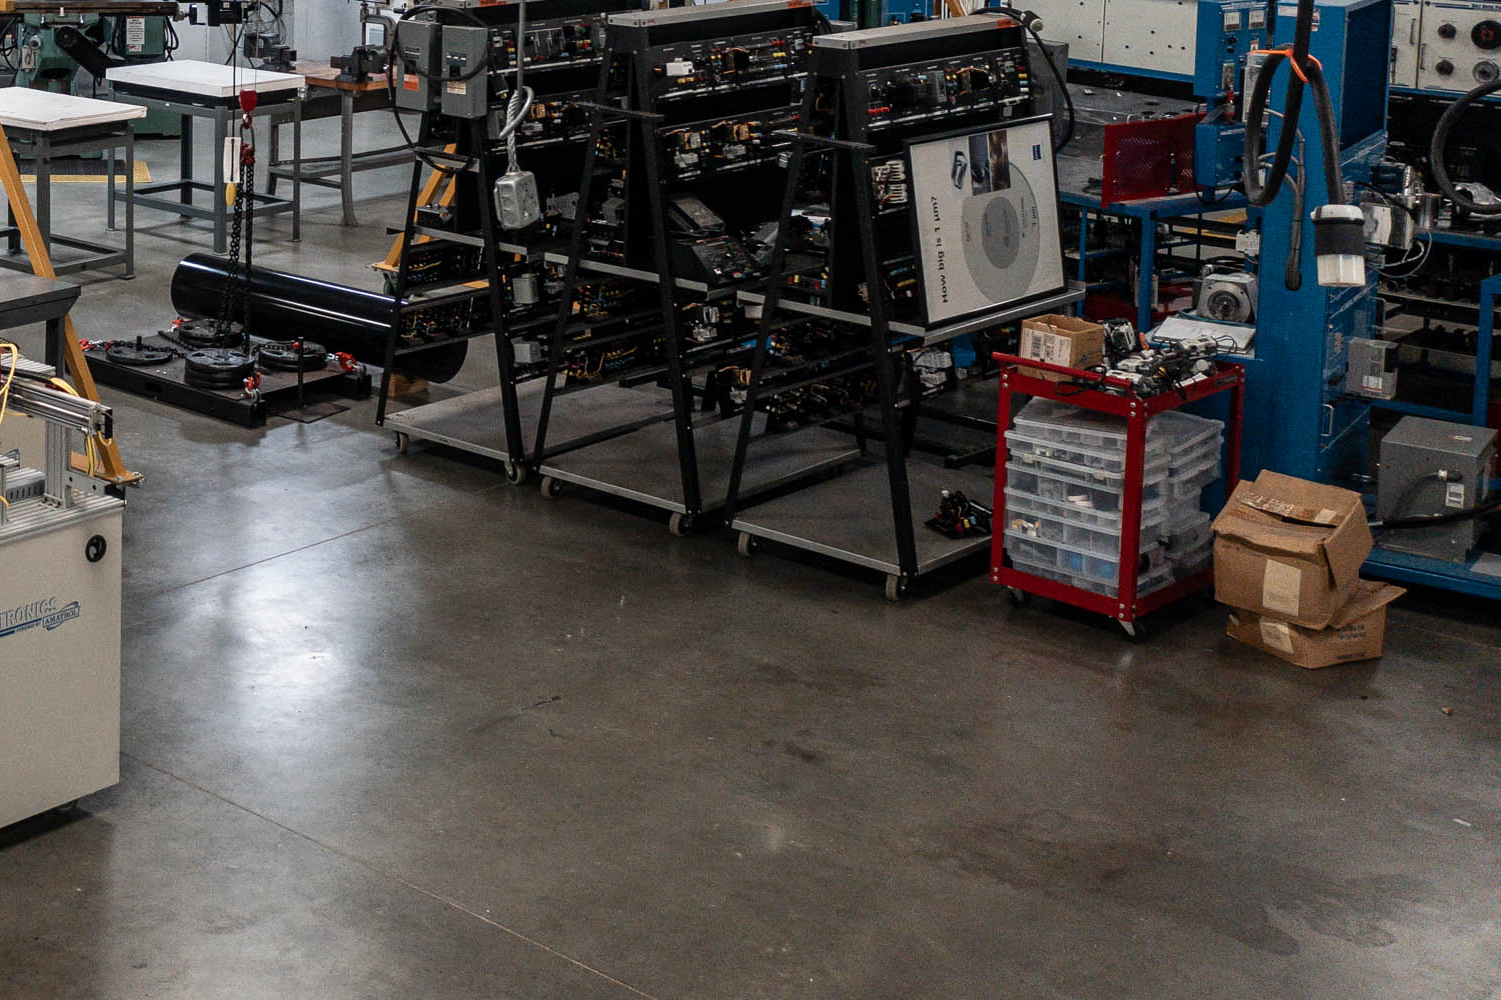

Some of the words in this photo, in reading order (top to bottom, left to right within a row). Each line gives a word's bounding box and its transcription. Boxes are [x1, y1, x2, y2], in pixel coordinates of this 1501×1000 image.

[936, 237, 942, 247] is
[937, 250, 946, 271] big
[940, 274, 948, 303] How
[44, 608, 77, 624] AMATROL
